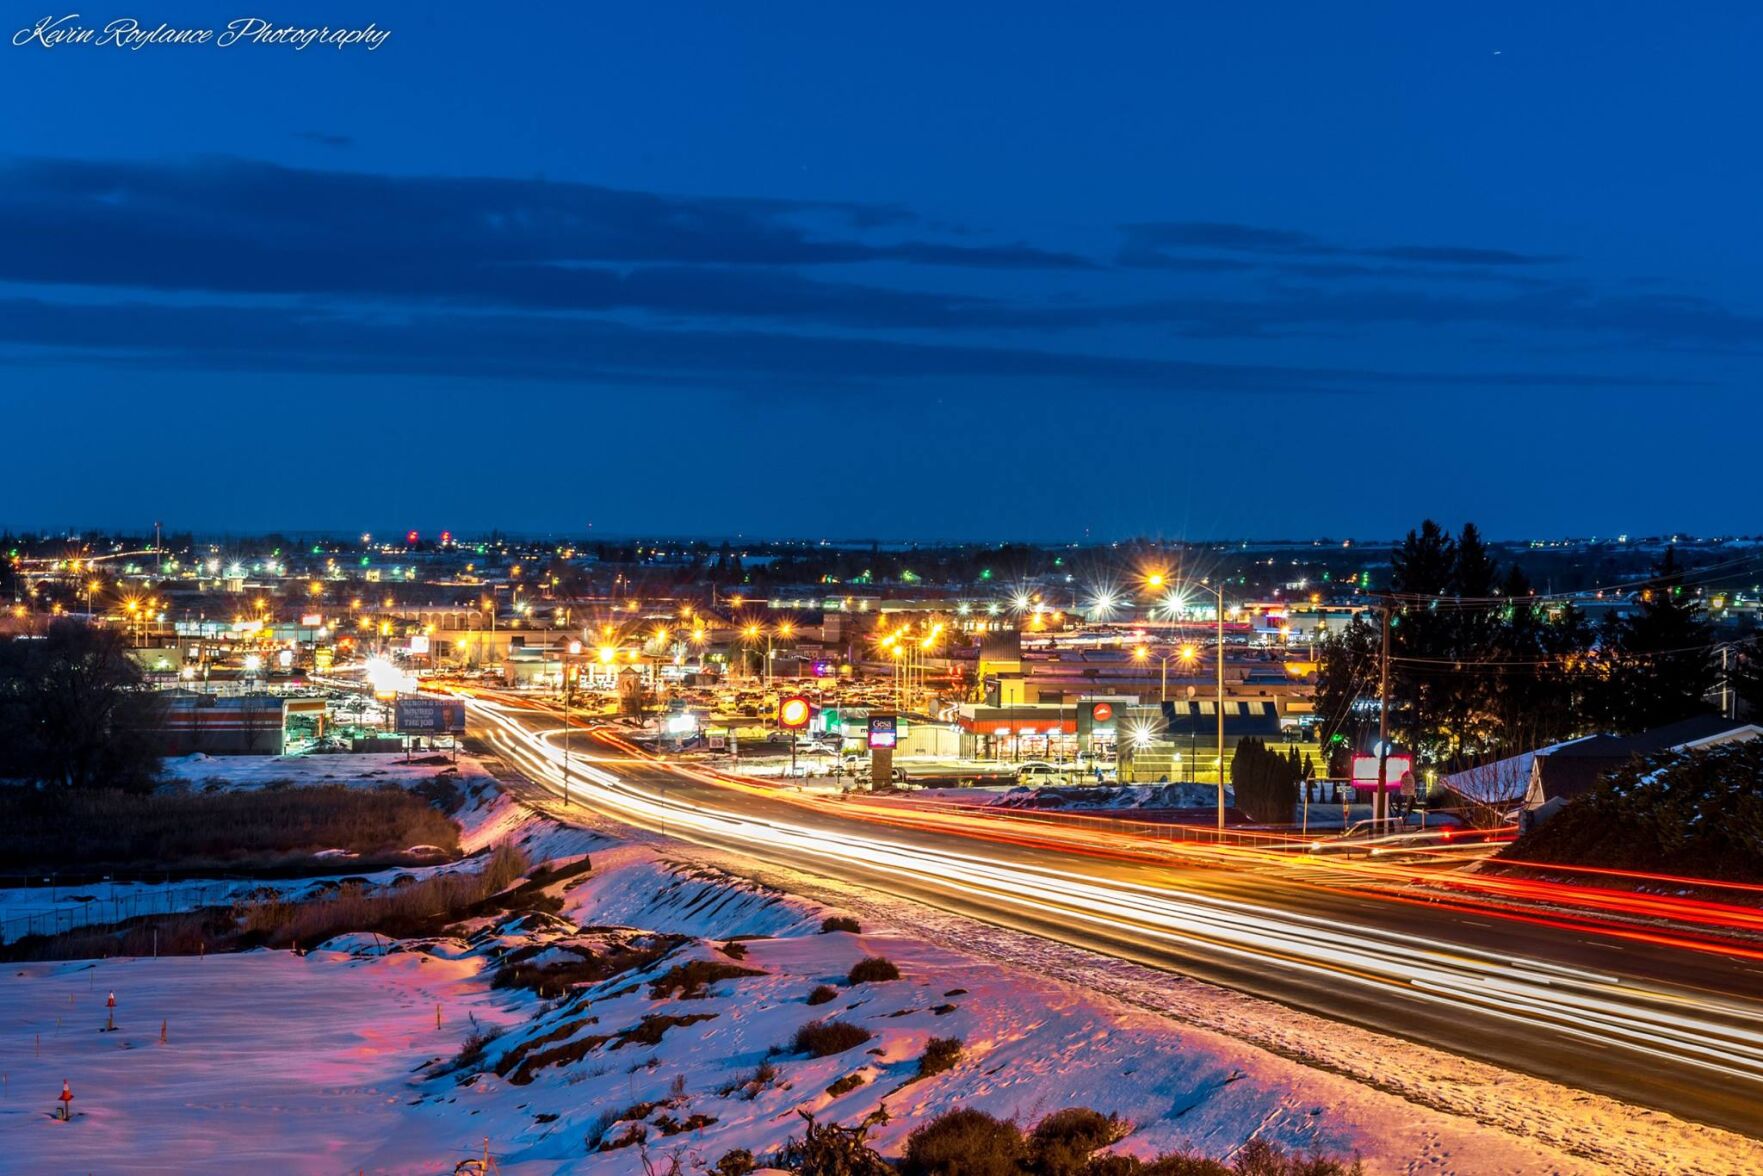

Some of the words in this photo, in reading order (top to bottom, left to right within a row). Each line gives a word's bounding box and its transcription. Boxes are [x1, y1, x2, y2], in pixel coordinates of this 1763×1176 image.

[404, 719, 419, 727] THE
[420, 719, 434, 727] JOB
[872, 719, 892, 730] Gesa
